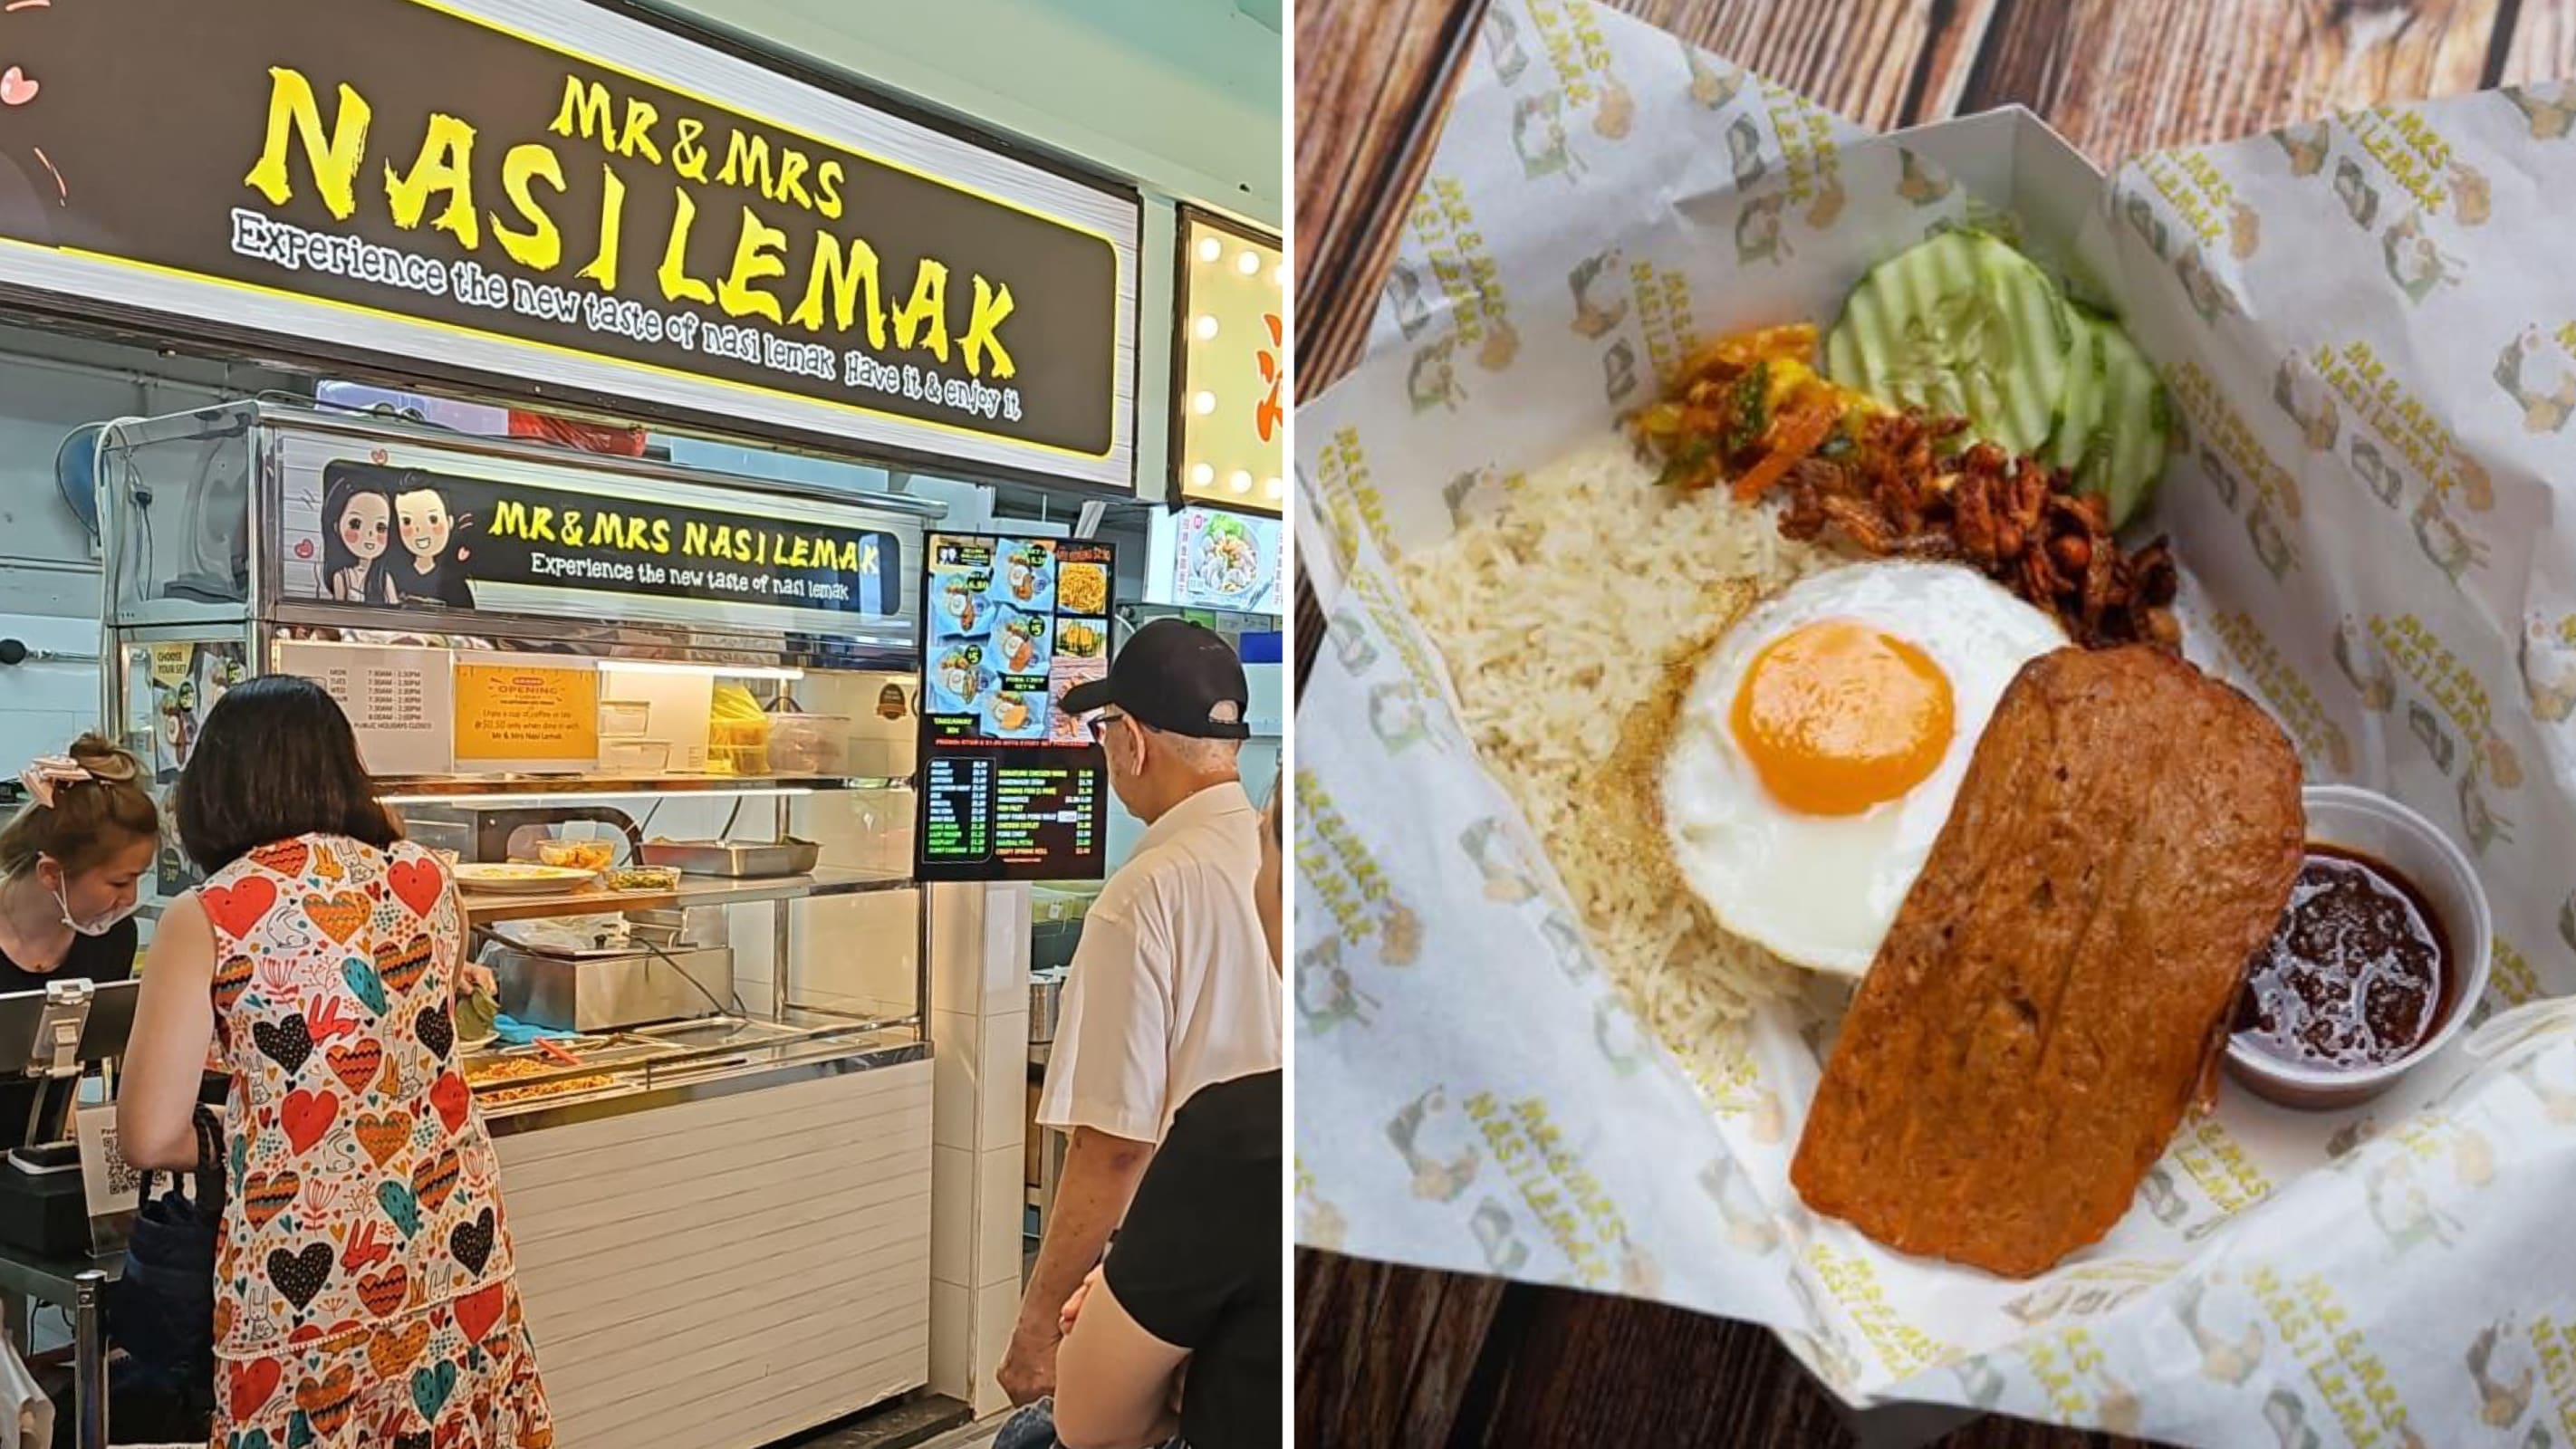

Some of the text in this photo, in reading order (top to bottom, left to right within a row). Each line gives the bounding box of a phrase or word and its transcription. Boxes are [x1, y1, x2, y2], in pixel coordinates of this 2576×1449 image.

[549, 73, 845, 219] MR & MRS
[245, 66, 626, 292] NASI
[658, 187, 1015, 379] LEMAK
[232, 208, 447, 296] Experience
[452, 262, 508, 305] the
[514, 280, 580, 322] new
[583, 291, 662, 341] taste
[667, 311, 699, 350] of
[703, 322, 761, 363] nasi
[764, 333, 836, 381] lemak
[845, 350, 899, 393] Have
[903, 369, 921, 399] it
[925, 372, 942, 403] &
[944, 379, 1001, 419] enjoy
[488, 500, 879, 575] MR & MRS NASI LEMAK
[531, 552, 850, 602] Experience the new taste of nasi lemak
[497, 685, 558, 695] OPENING
